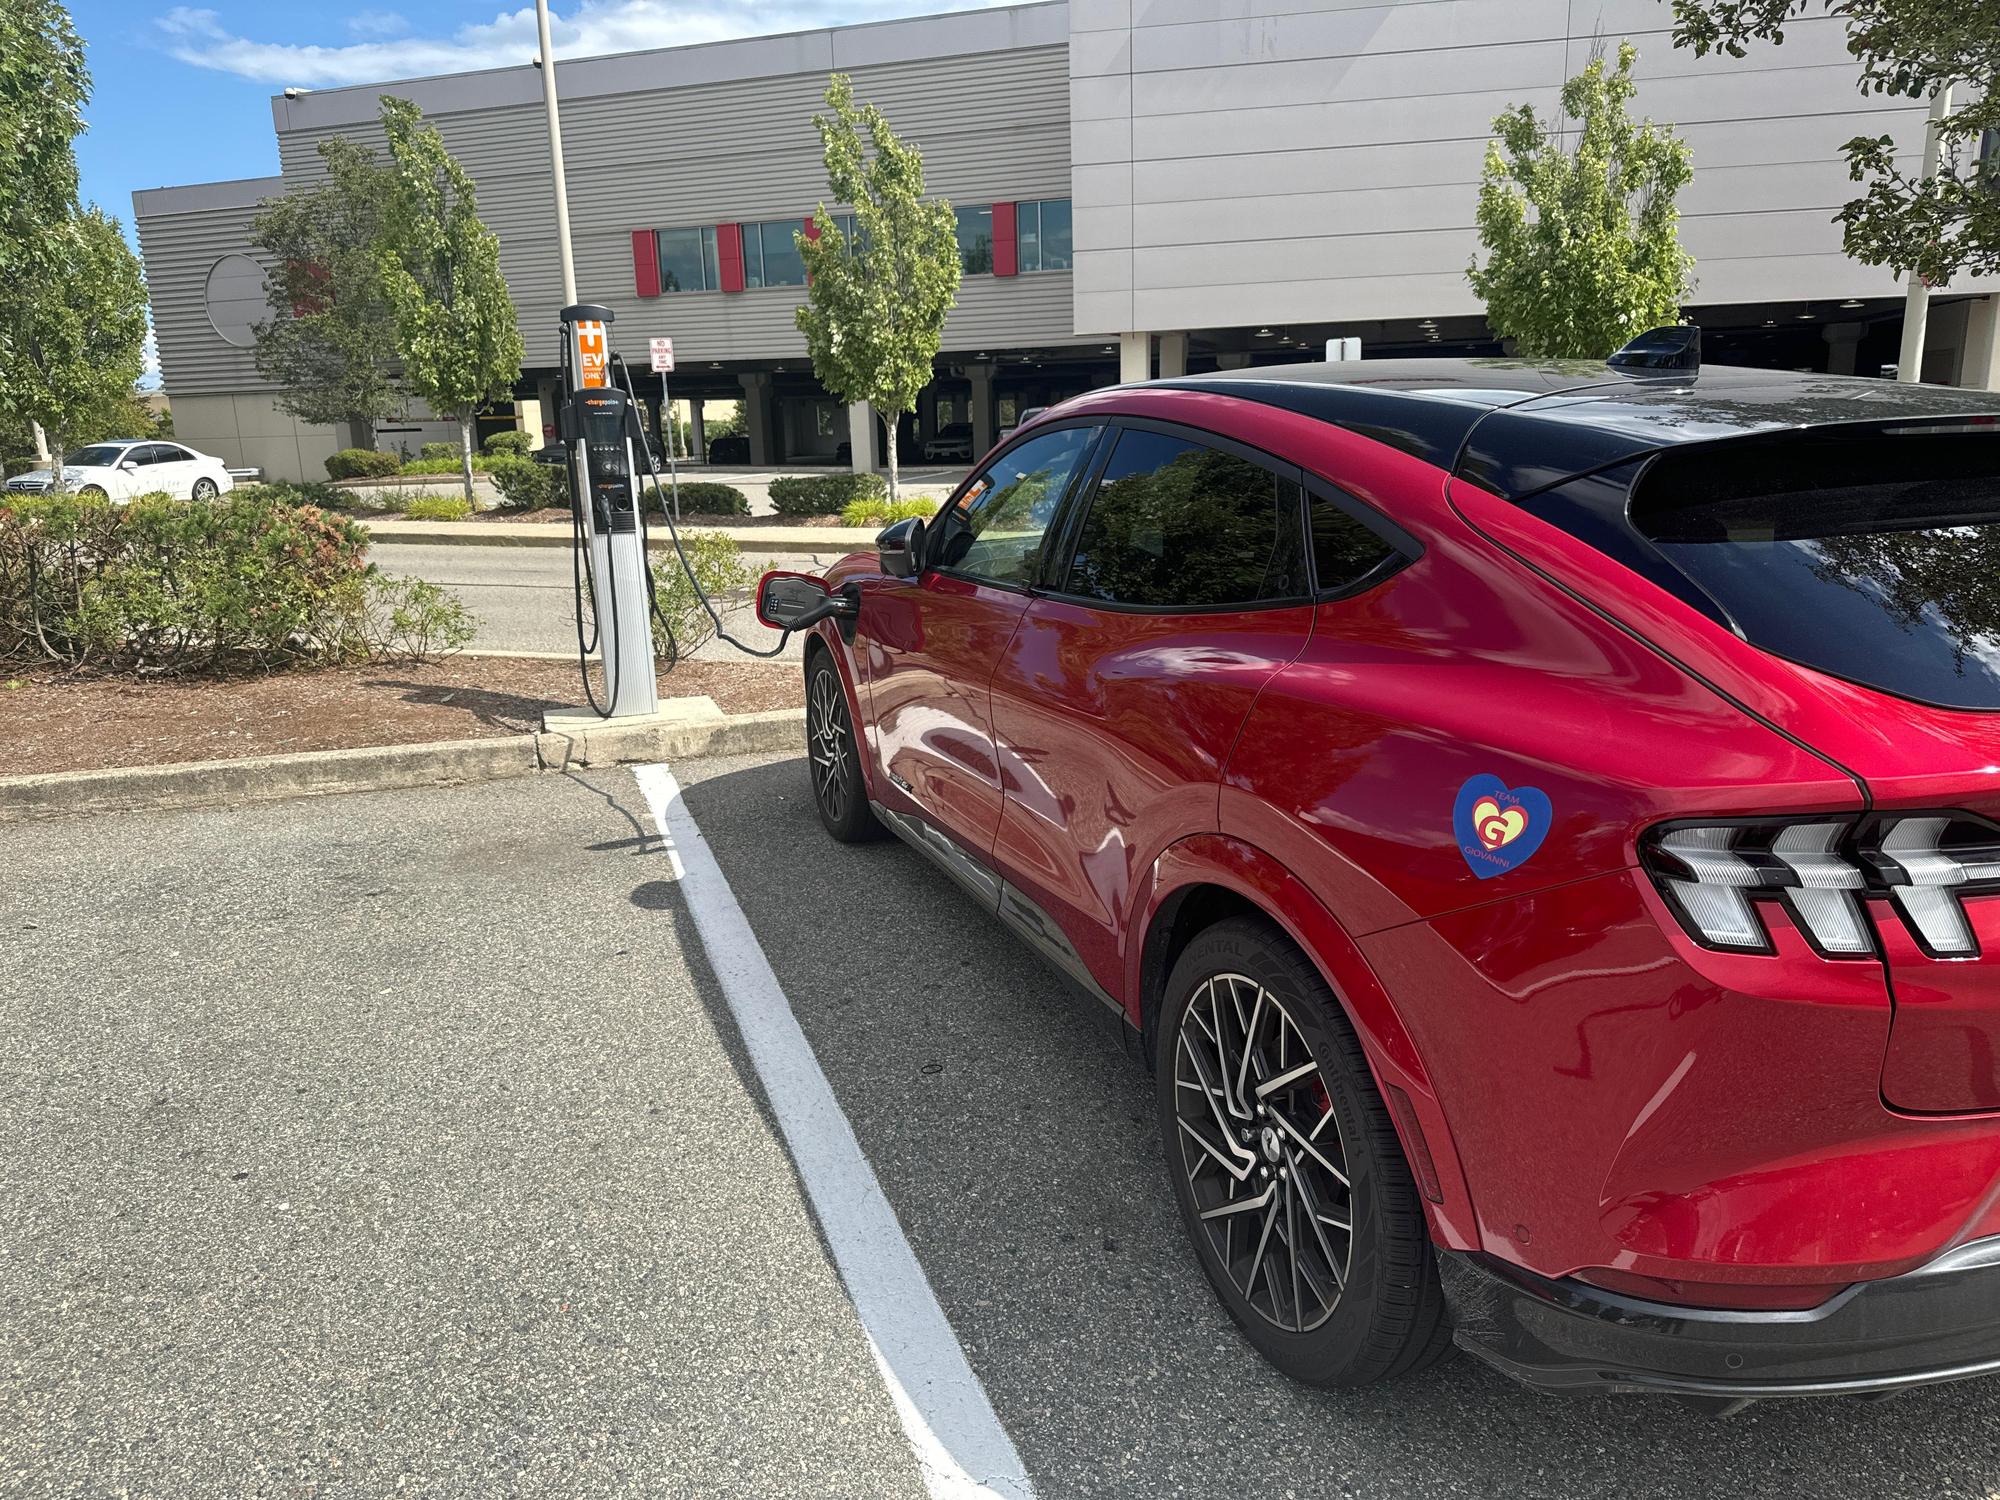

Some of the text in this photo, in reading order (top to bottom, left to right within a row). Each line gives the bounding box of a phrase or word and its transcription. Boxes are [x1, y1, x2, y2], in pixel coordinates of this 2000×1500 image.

[582, 353, 602, 367] EV
[584, 372, 604, 380] ONLY
[1494, 790, 1520, 805] TEAM
[1478, 815, 1509, 847] G
[1464, 846, 1511, 868] GIOVANNI
